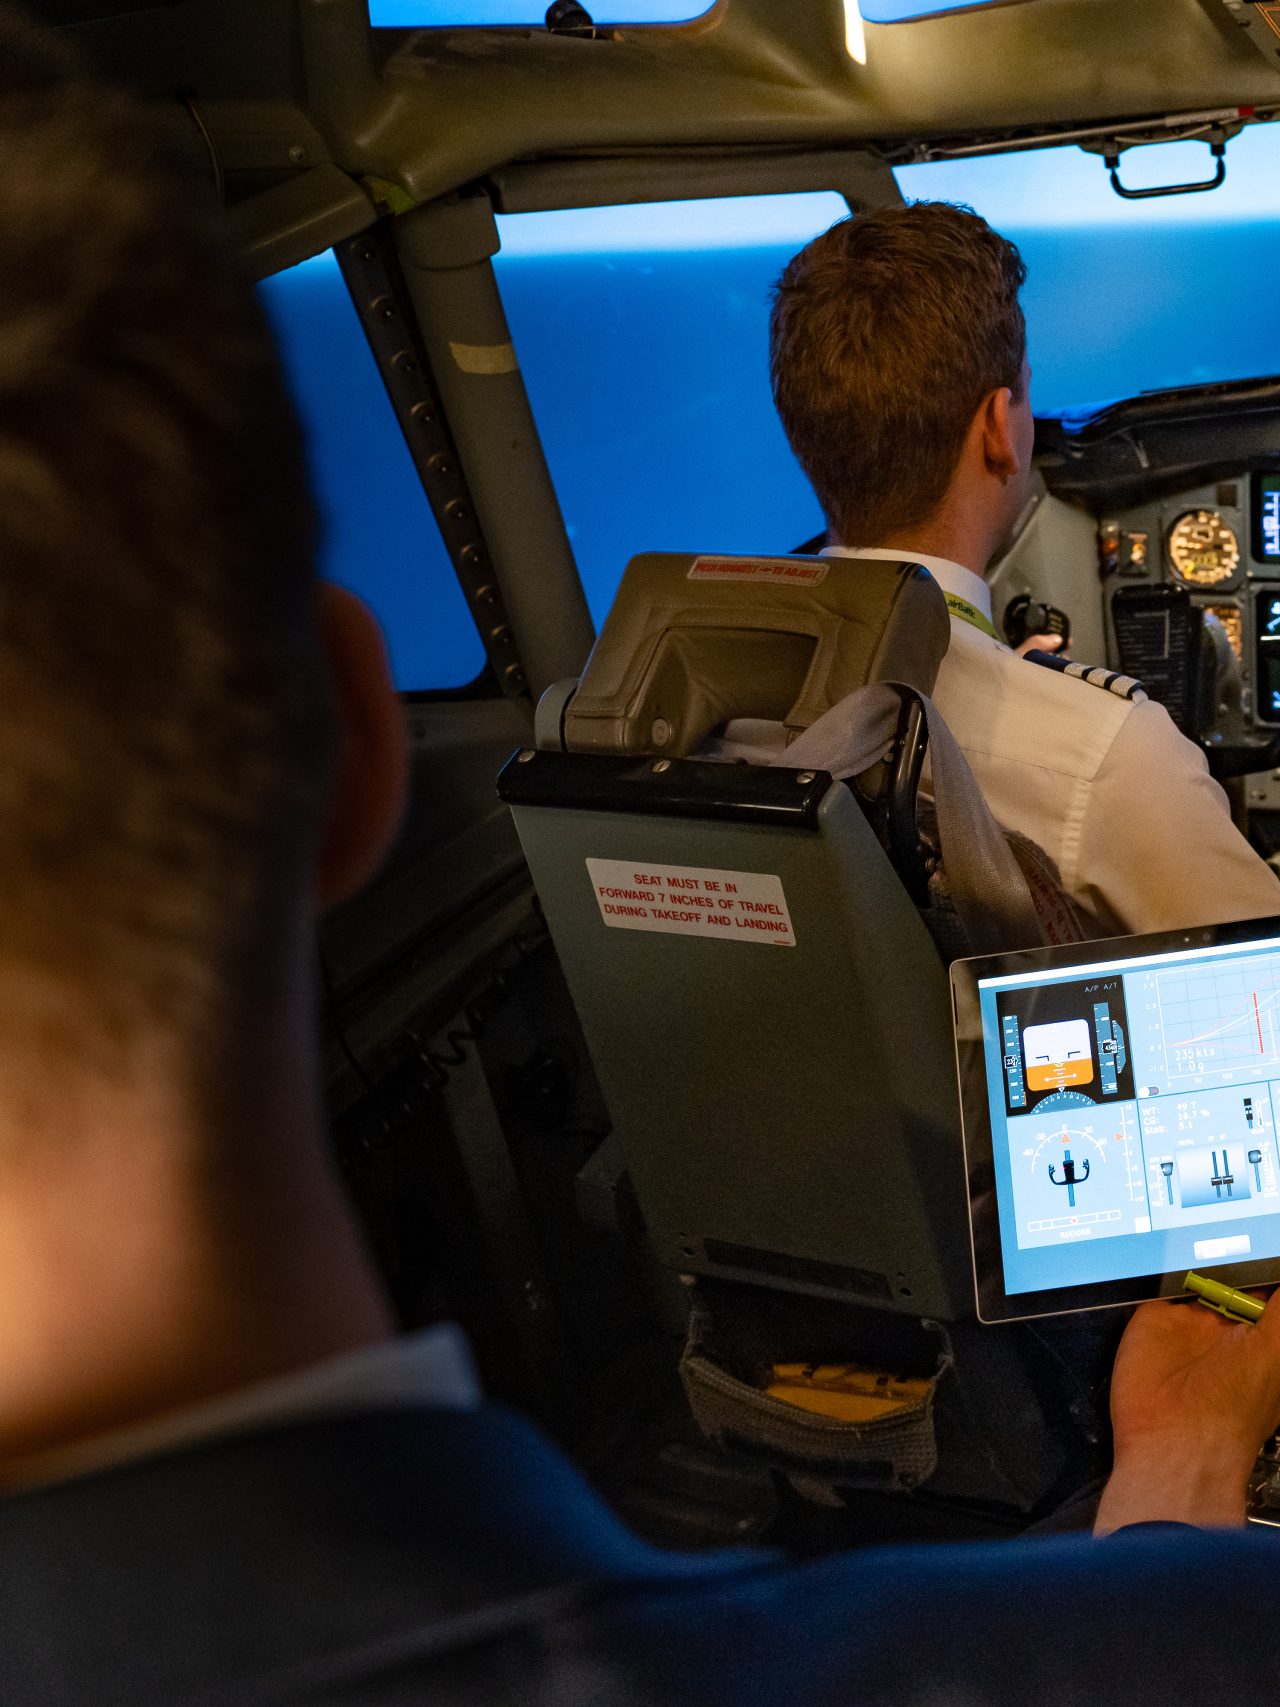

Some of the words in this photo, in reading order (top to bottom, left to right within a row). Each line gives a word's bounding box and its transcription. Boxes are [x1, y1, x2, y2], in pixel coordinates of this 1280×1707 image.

[784, 568, 820, 579] ADJUST
[634, 874, 662, 886] SEAT
[667, 877, 699, 889] MUST
[704, 881, 720, 891] BE
[725, 883, 738, 893] IN
[599, 887, 654, 902] FORWARD
[659, 893, 665, 903] 7
[670, 894, 714, 908] INCHES
[719, 899, 734, 909] OF
[738, 901, 783, 915] TRAVEL
[604, 904, 647, 918] DURING
[651, 910, 702, 922] TAKEOFF
[707, 915, 731, 926] AND
[736, 918, 788, 933] LANDING
[1084, 984, 1099, 992] A/P
[1103, 982, 1117, 990] A/T
[1143, 1106, 1160, 1116] WT:
[1143, 1117, 1159, 1126] CG:
[1144, 1125, 1168, 1135] Stab:
